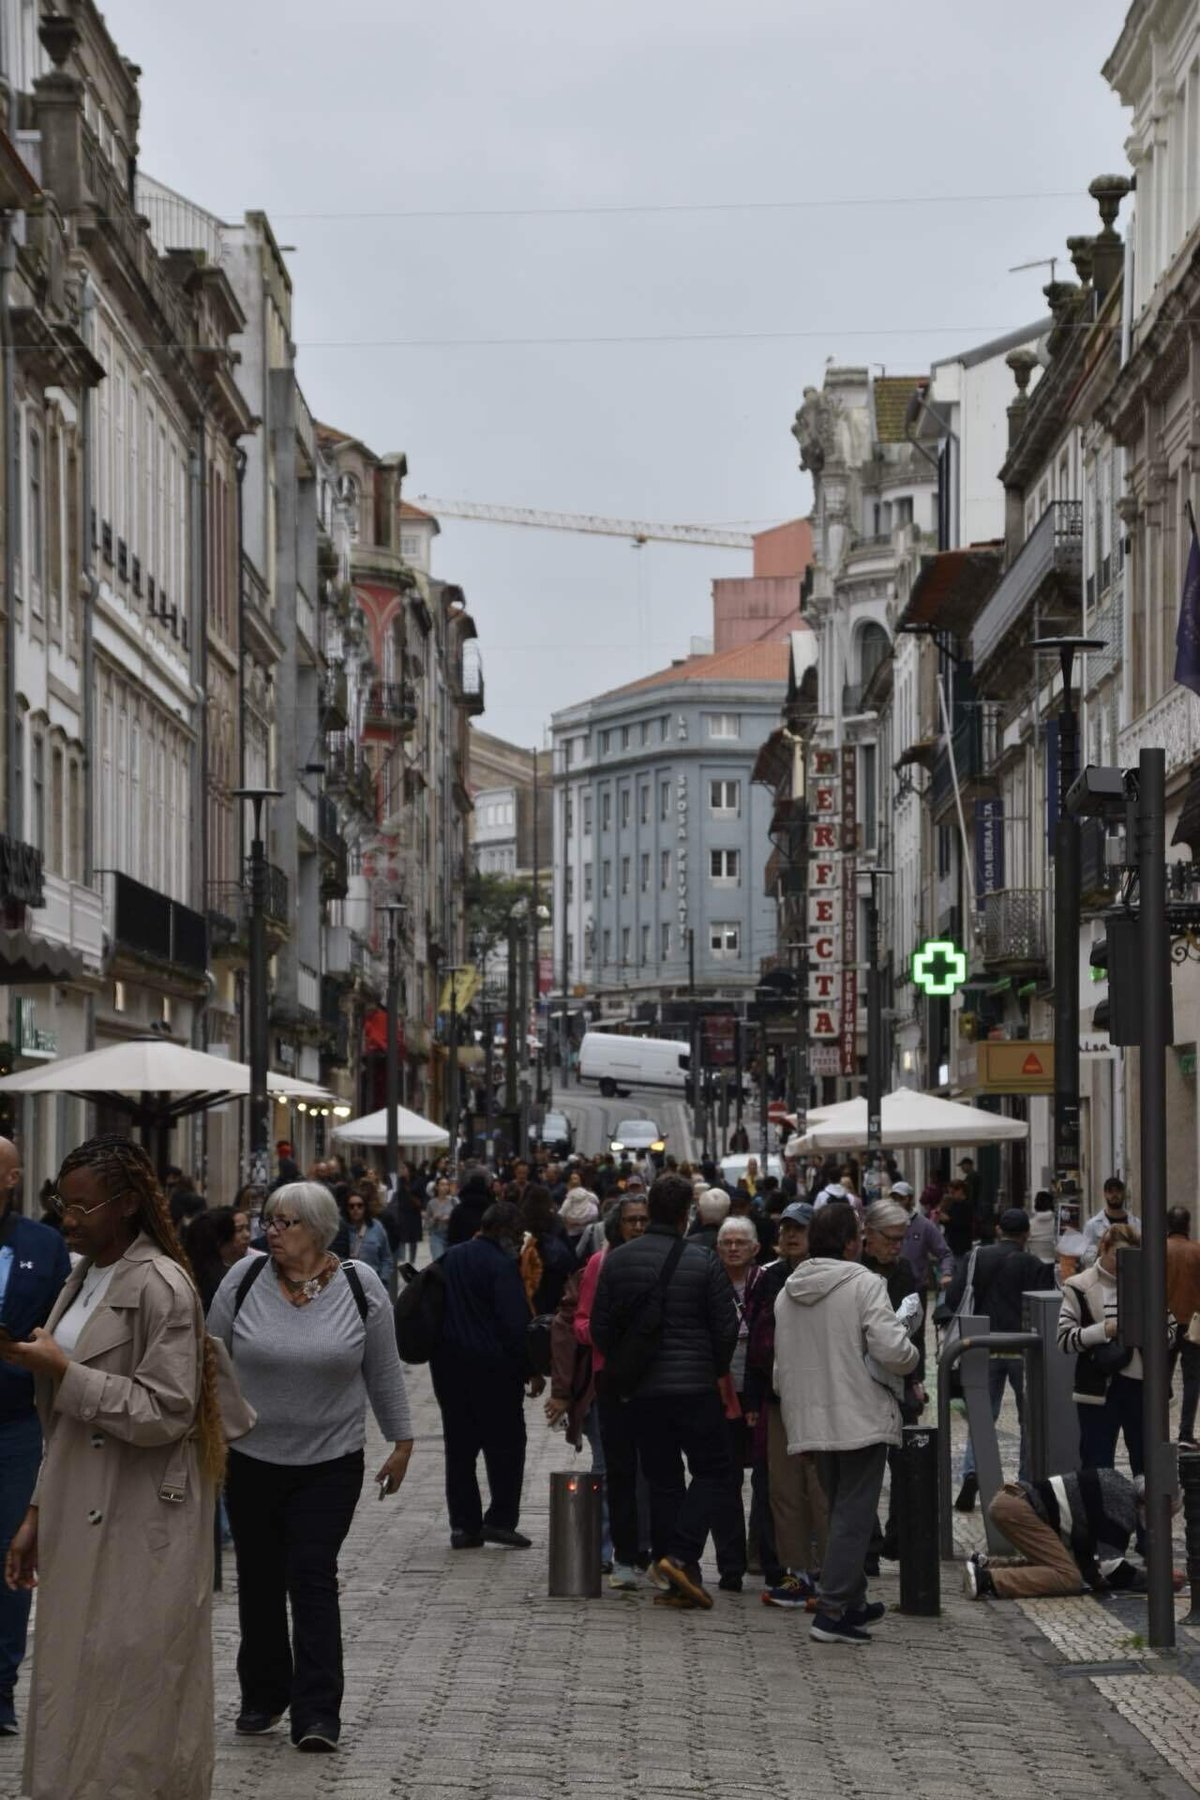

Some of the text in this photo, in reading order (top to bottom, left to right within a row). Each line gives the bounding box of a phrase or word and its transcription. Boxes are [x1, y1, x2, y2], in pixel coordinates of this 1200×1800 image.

[678, 714, 687, 738] LA
[678, 775, 687, 837] SPOSA
[814, 752, 835, 1034] PERFECTA
[844, 858, 854, 962] UTILIDADES
[984, 862, 994, 878] DA
[844, 971, 854, 1073] PERFUMARIA
